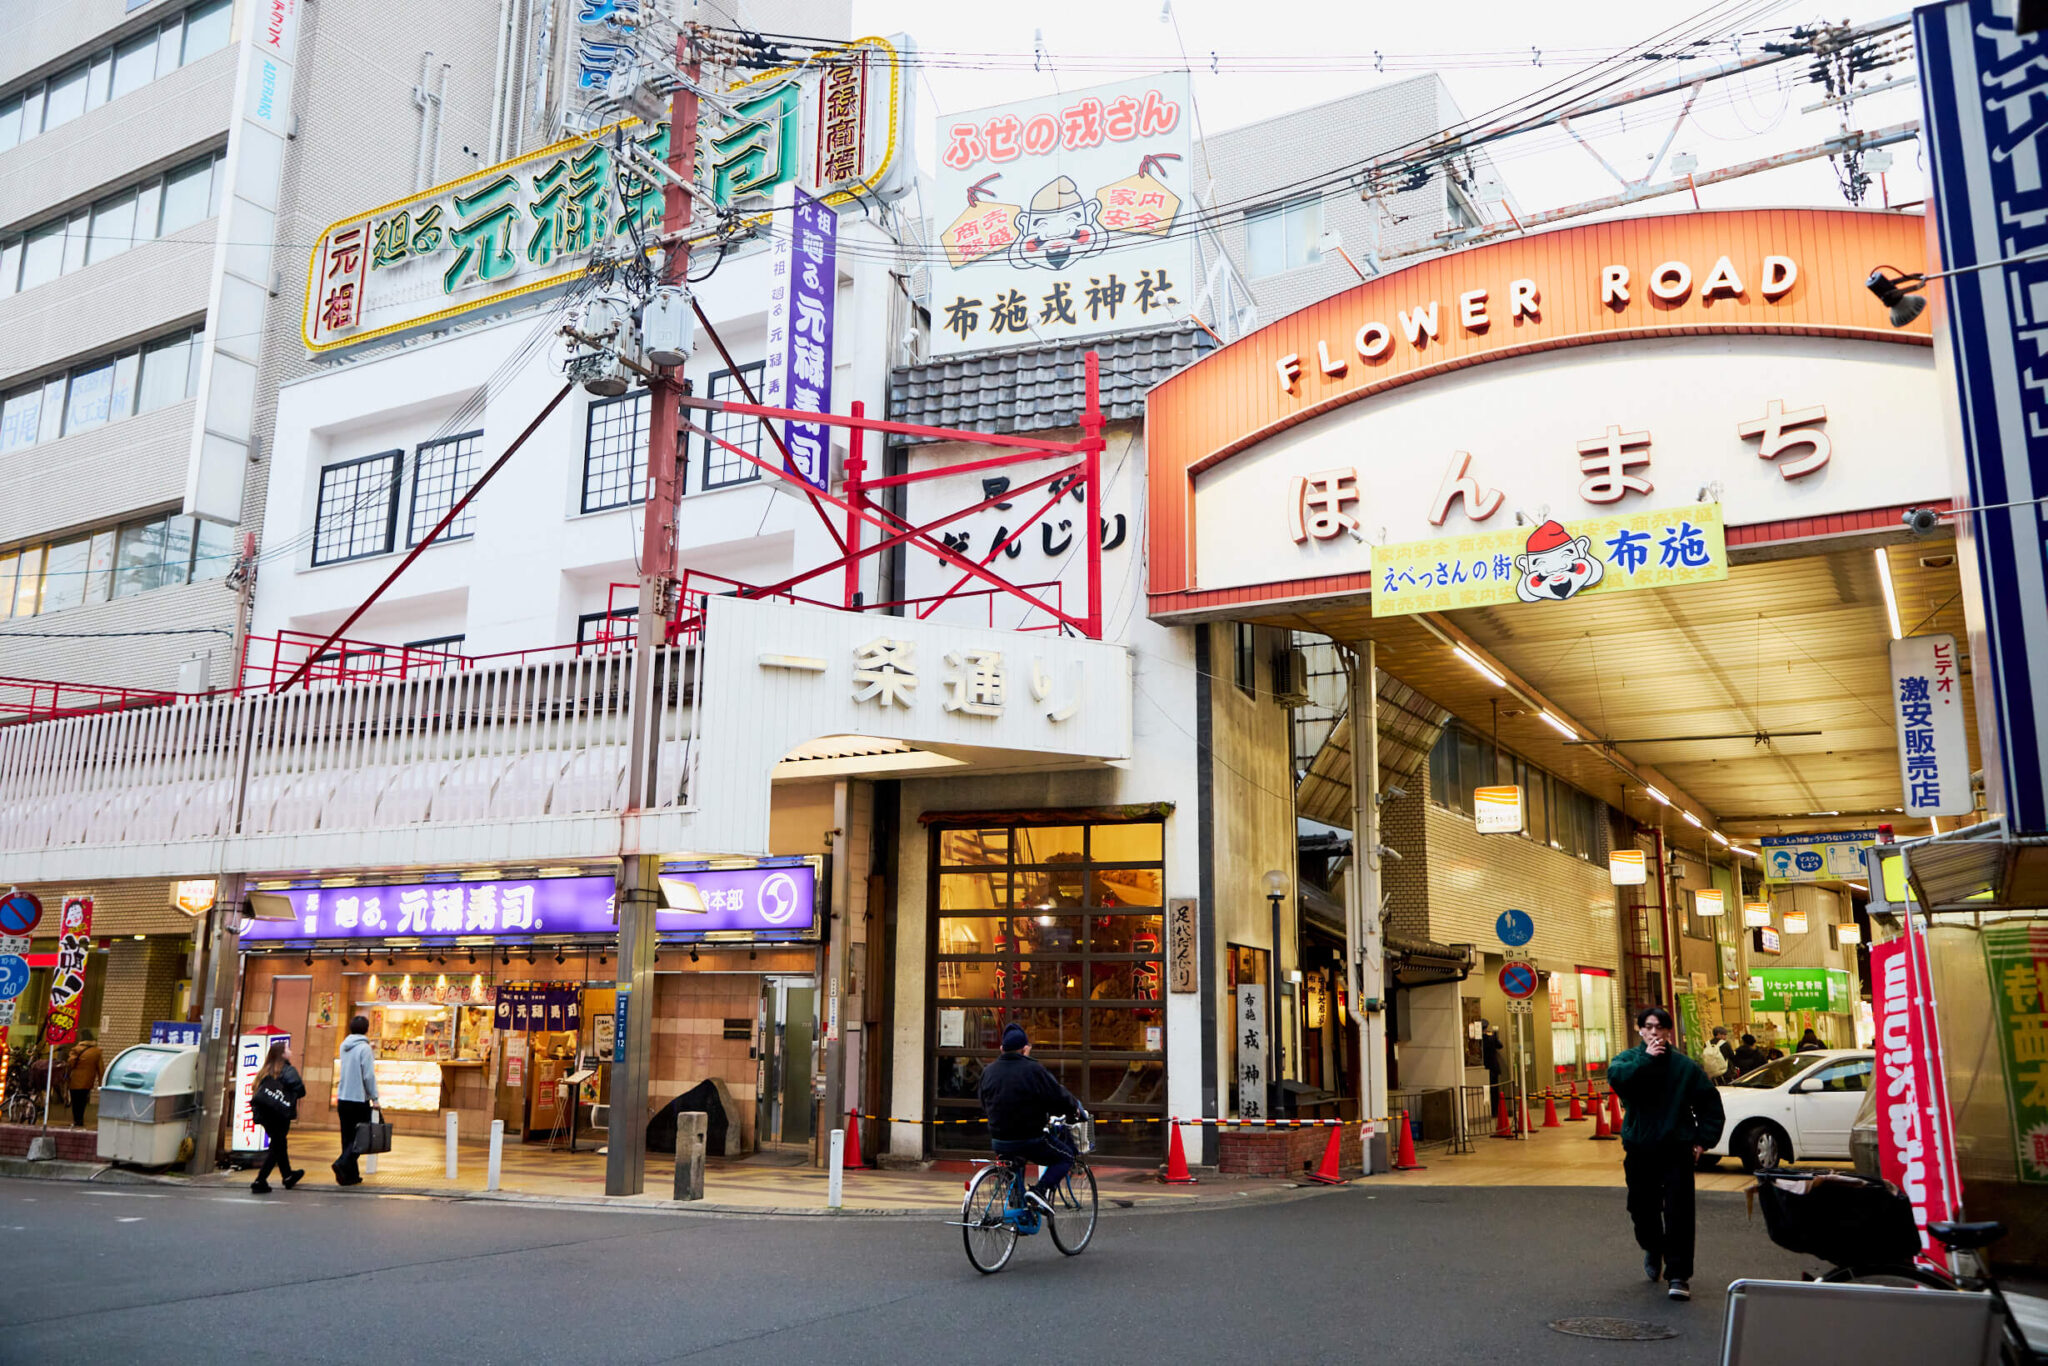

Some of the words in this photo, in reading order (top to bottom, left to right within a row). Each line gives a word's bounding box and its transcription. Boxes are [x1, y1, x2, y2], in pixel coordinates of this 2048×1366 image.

[257, 59, 277, 120] ADERANS
[824, 56, 860, 183] 登録商標
[943, 89, 1179, 171] ふせの戎さん
[797, 197, 833, 235] 元祖
[953, 208, 1008, 244] 商売
[1104, 209, 1162, 230] 安全
[1107, 187, 1166, 208] 家内
[320, 227, 364, 334] 元祖
[944, 269, 1186, 341] 布施戎神社
[1275, 277, 1544, 394] FLOWER
[1600, 254, 1799, 307] ROAD
[1287, 397, 1834, 545] ほんまち
[1382, 553, 1513, 594] えべっさんの街
[1604, 521, 1712, 577] 布施
[757, 636, 1085, 724] 一条通り
[1899, 676, 1941, 808] 激安販売店
[1175, 905, 1192, 986] 足代だんじり
[2, 982, 17, 995] 60
[1244, 992, 1262, 1119] 布施戎神社
